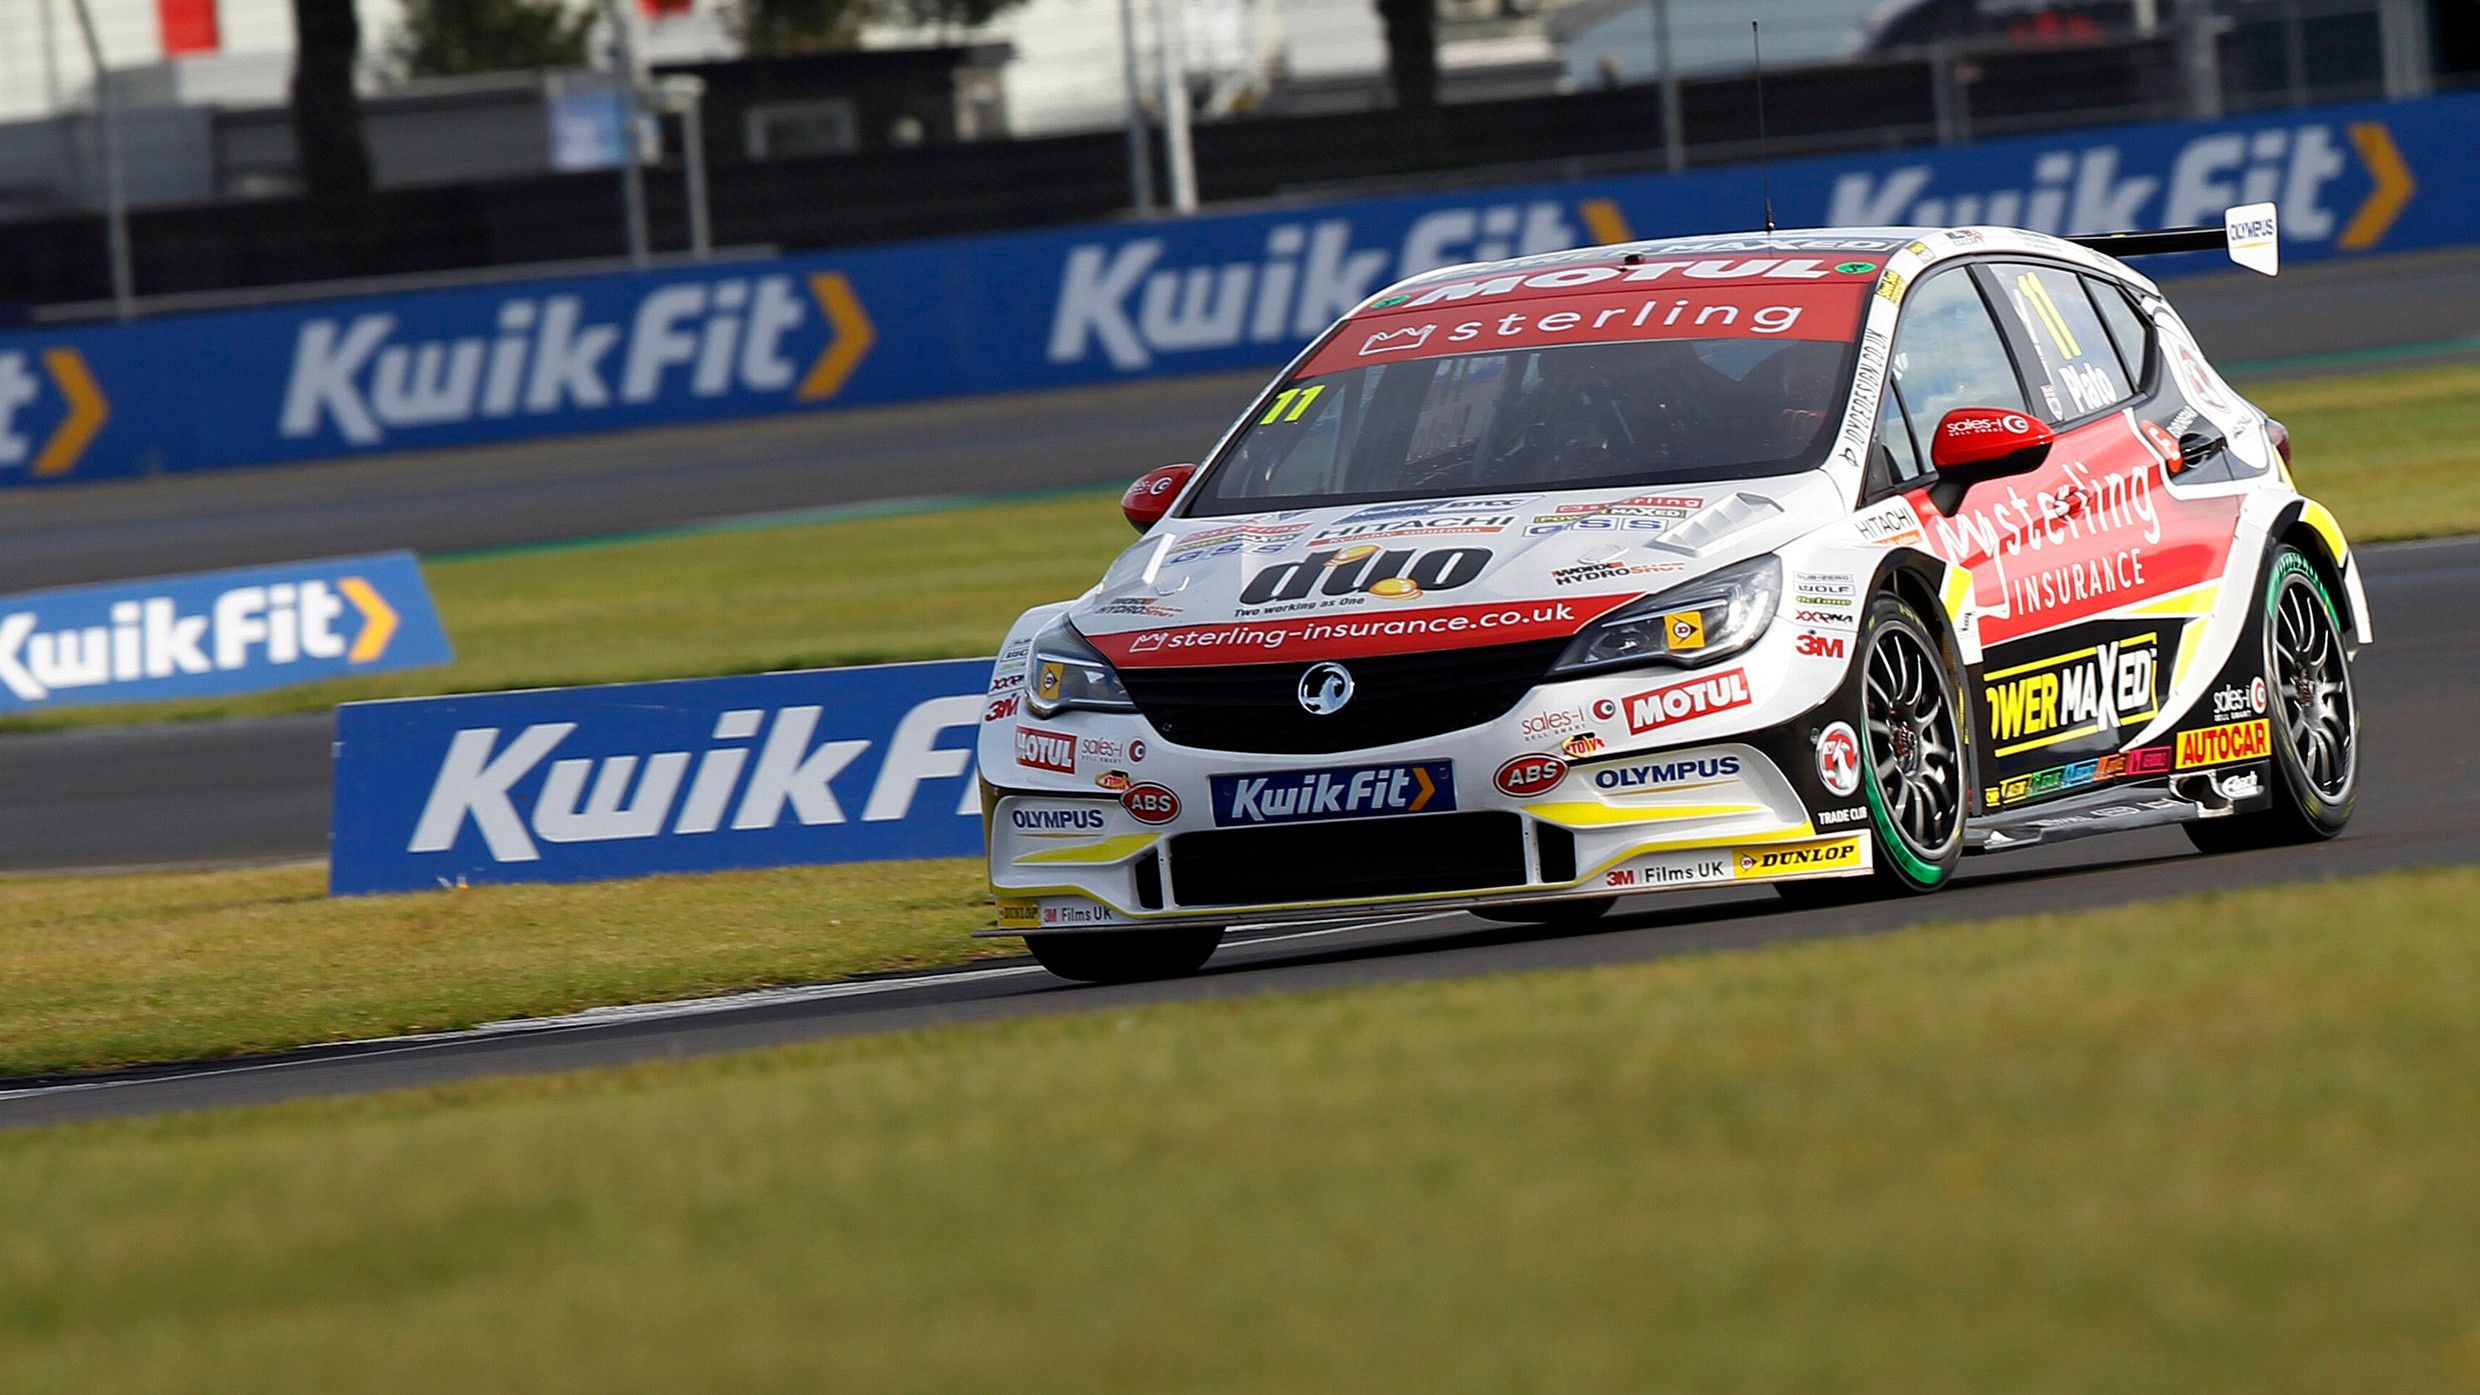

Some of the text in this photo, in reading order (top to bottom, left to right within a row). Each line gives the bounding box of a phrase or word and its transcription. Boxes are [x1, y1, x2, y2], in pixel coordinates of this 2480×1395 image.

[1402, 258, 1830, 308] MOTUL
[1447, 299, 1803, 343] sterling
[2016, 271, 2083, 360] 11
[2058, 362, 2117, 414] Plato
[1260, 384, 1325, 426] 11
[1315, 516, 1516, 539] HITACHI
[1611, 507, 1680, 518] MAXED
[1855, 507, 1916, 540] HITACHI
[2014, 548, 2146, 616] INSURANCE
[1234, 596, 1366, 618] Two working as One
[1167, 603, 1575, 649] sterling-insurance.co.uk
[1795, 634, 1844, 659] 3M
[1633, 673, 1750, 730] MOTUL
[2060, 641, 2151, 732] MAXED
[985, 696, 1020, 721] 3M
[1016, 732, 1073, 769] MOTUL
[2182, 722, 2267, 766] AUTOCAR
[407, 694, 983, 863] KwikF
[1507, 760, 1558, 787] ABS
[1595, 756, 1740, 789] OLYMPUS
[1012, 810, 1105, 829] OLYMPUS
[1131, 794, 1172, 813] ABS
[1818, 808, 1850, 825] TRADE
[1760, 845, 1855, 868] DUNLOP
[1606, 861, 1725, 887] 3M Films UK
[1044, 908, 1057, 922] 3M
[1061, 908, 1092, 922] Films
[1093, 906, 1113, 920] UK
